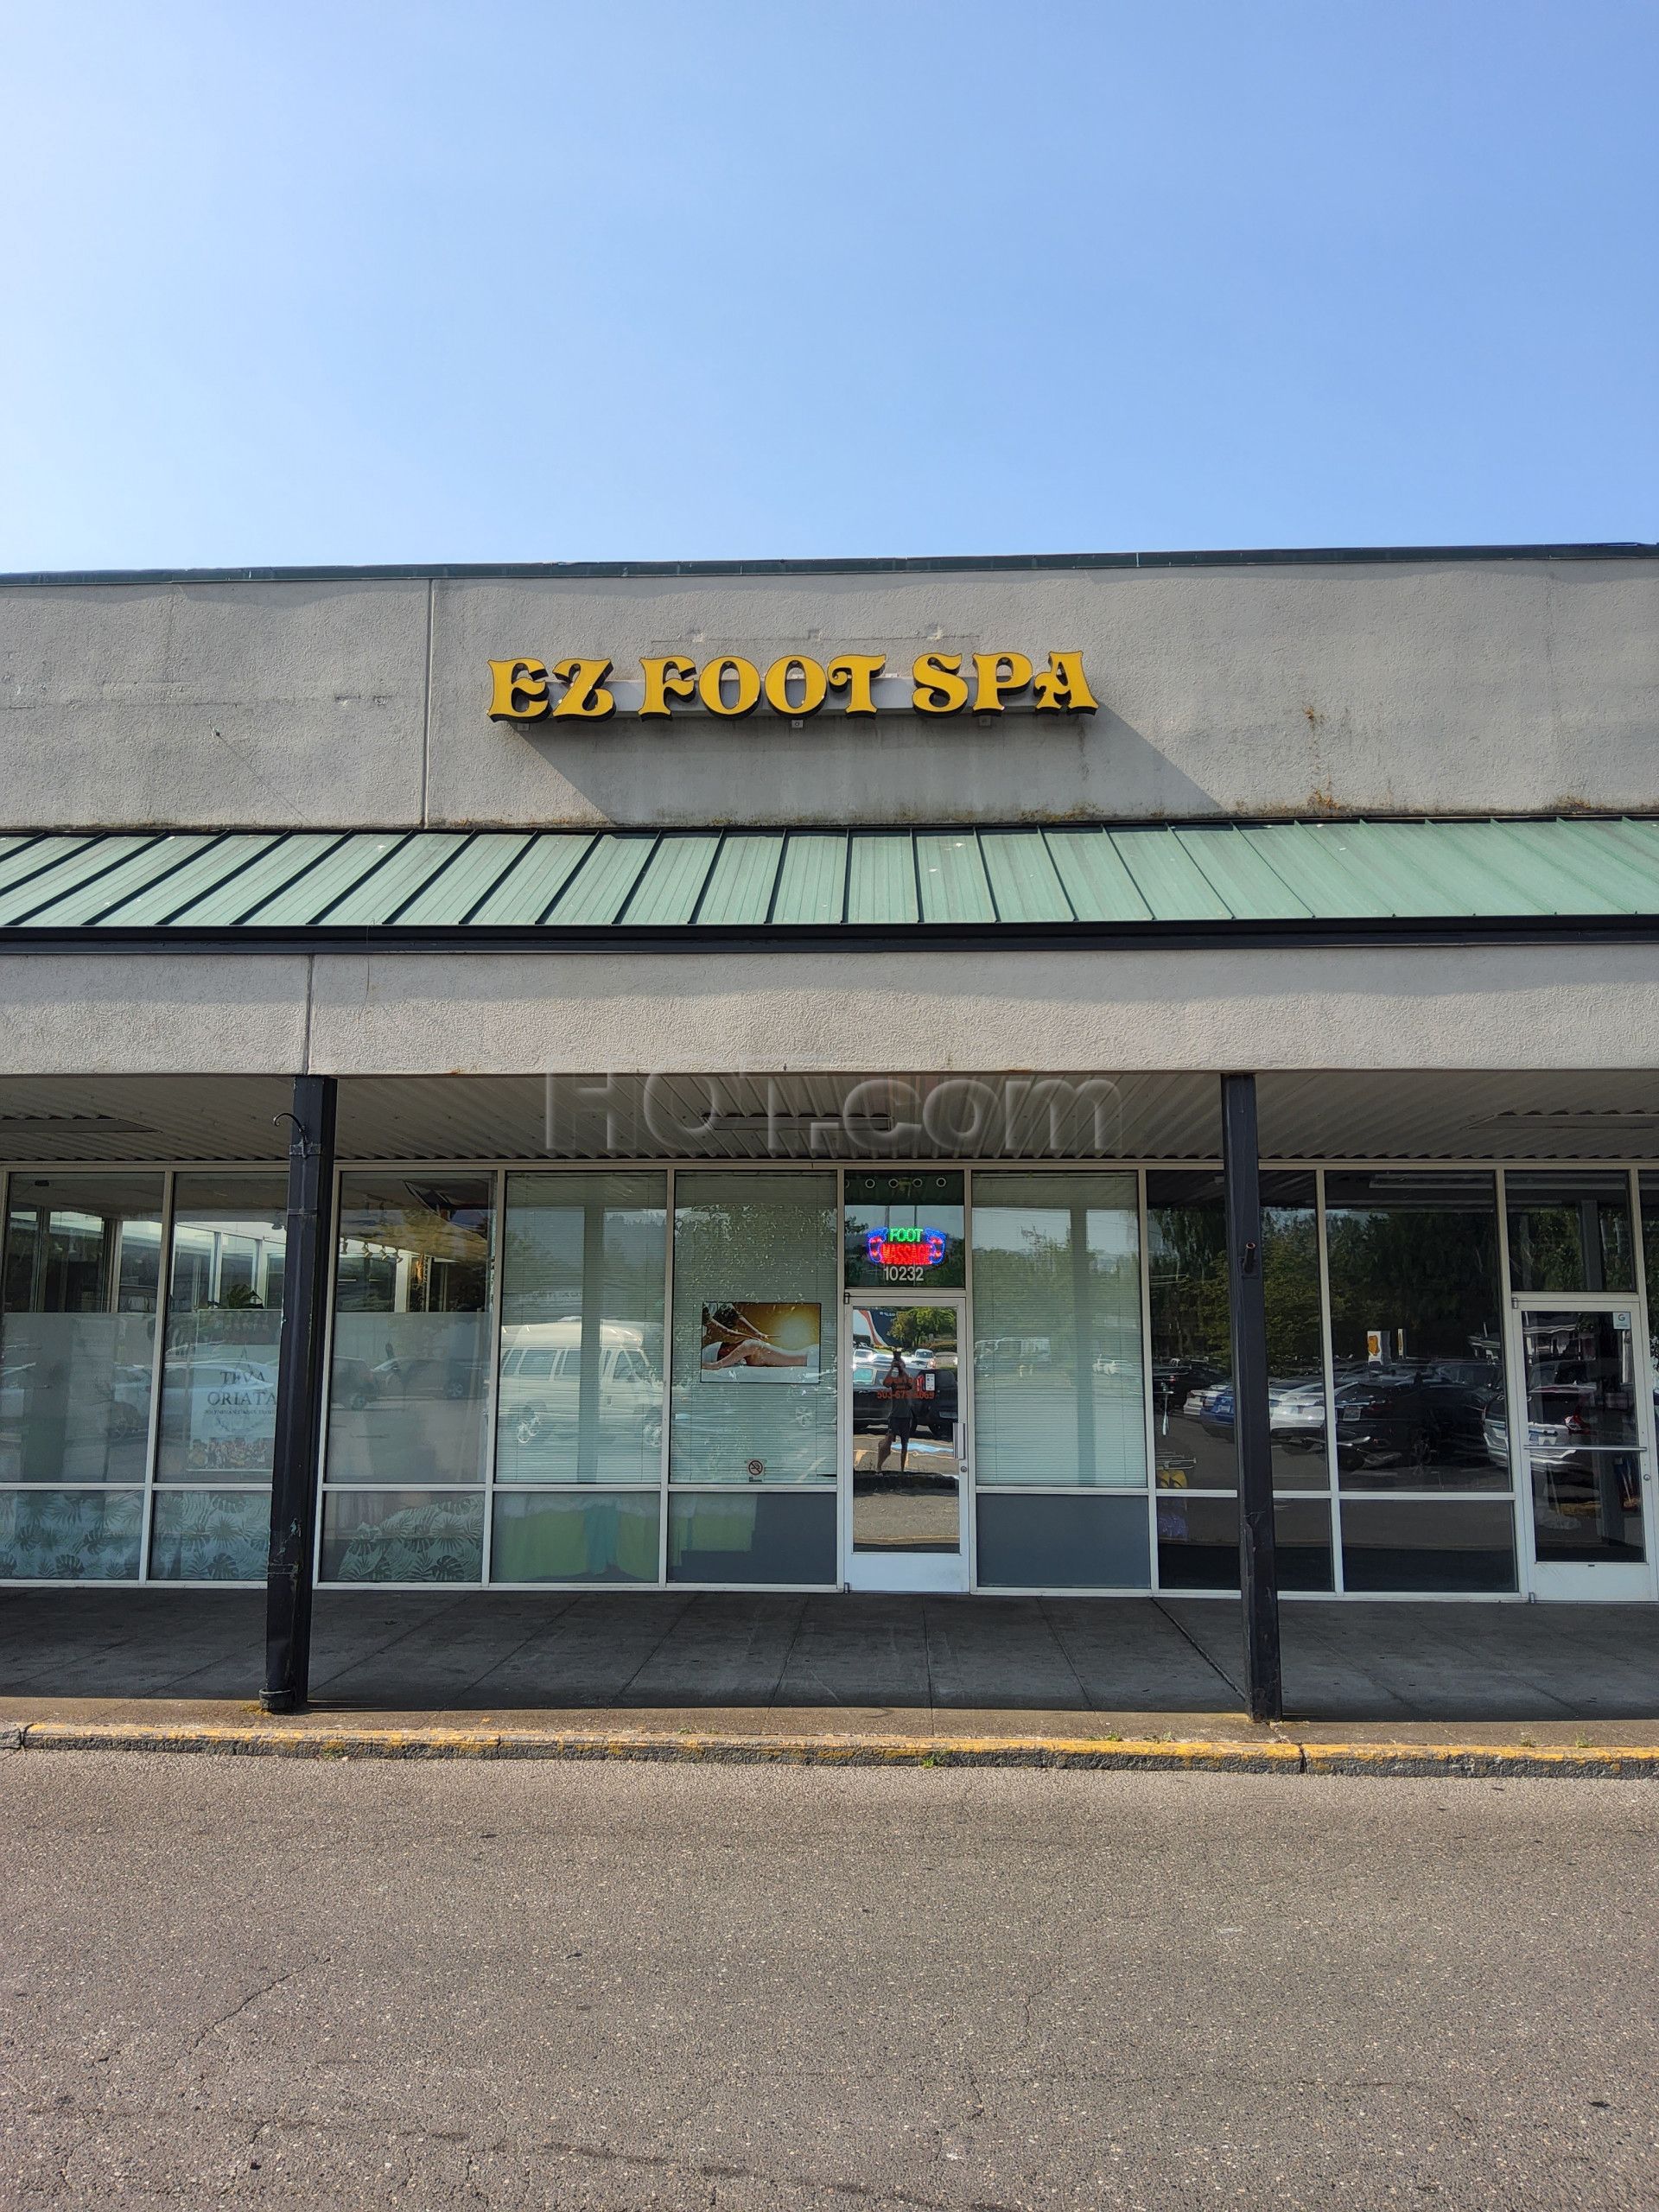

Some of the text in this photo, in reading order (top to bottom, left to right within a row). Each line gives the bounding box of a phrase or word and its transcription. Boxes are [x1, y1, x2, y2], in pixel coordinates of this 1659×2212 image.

[486, 652, 1099, 721] EZ FOOT SPA
[889, 1228, 923, 1242] FOOT
[884, 1266, 924, 1281] 10232
